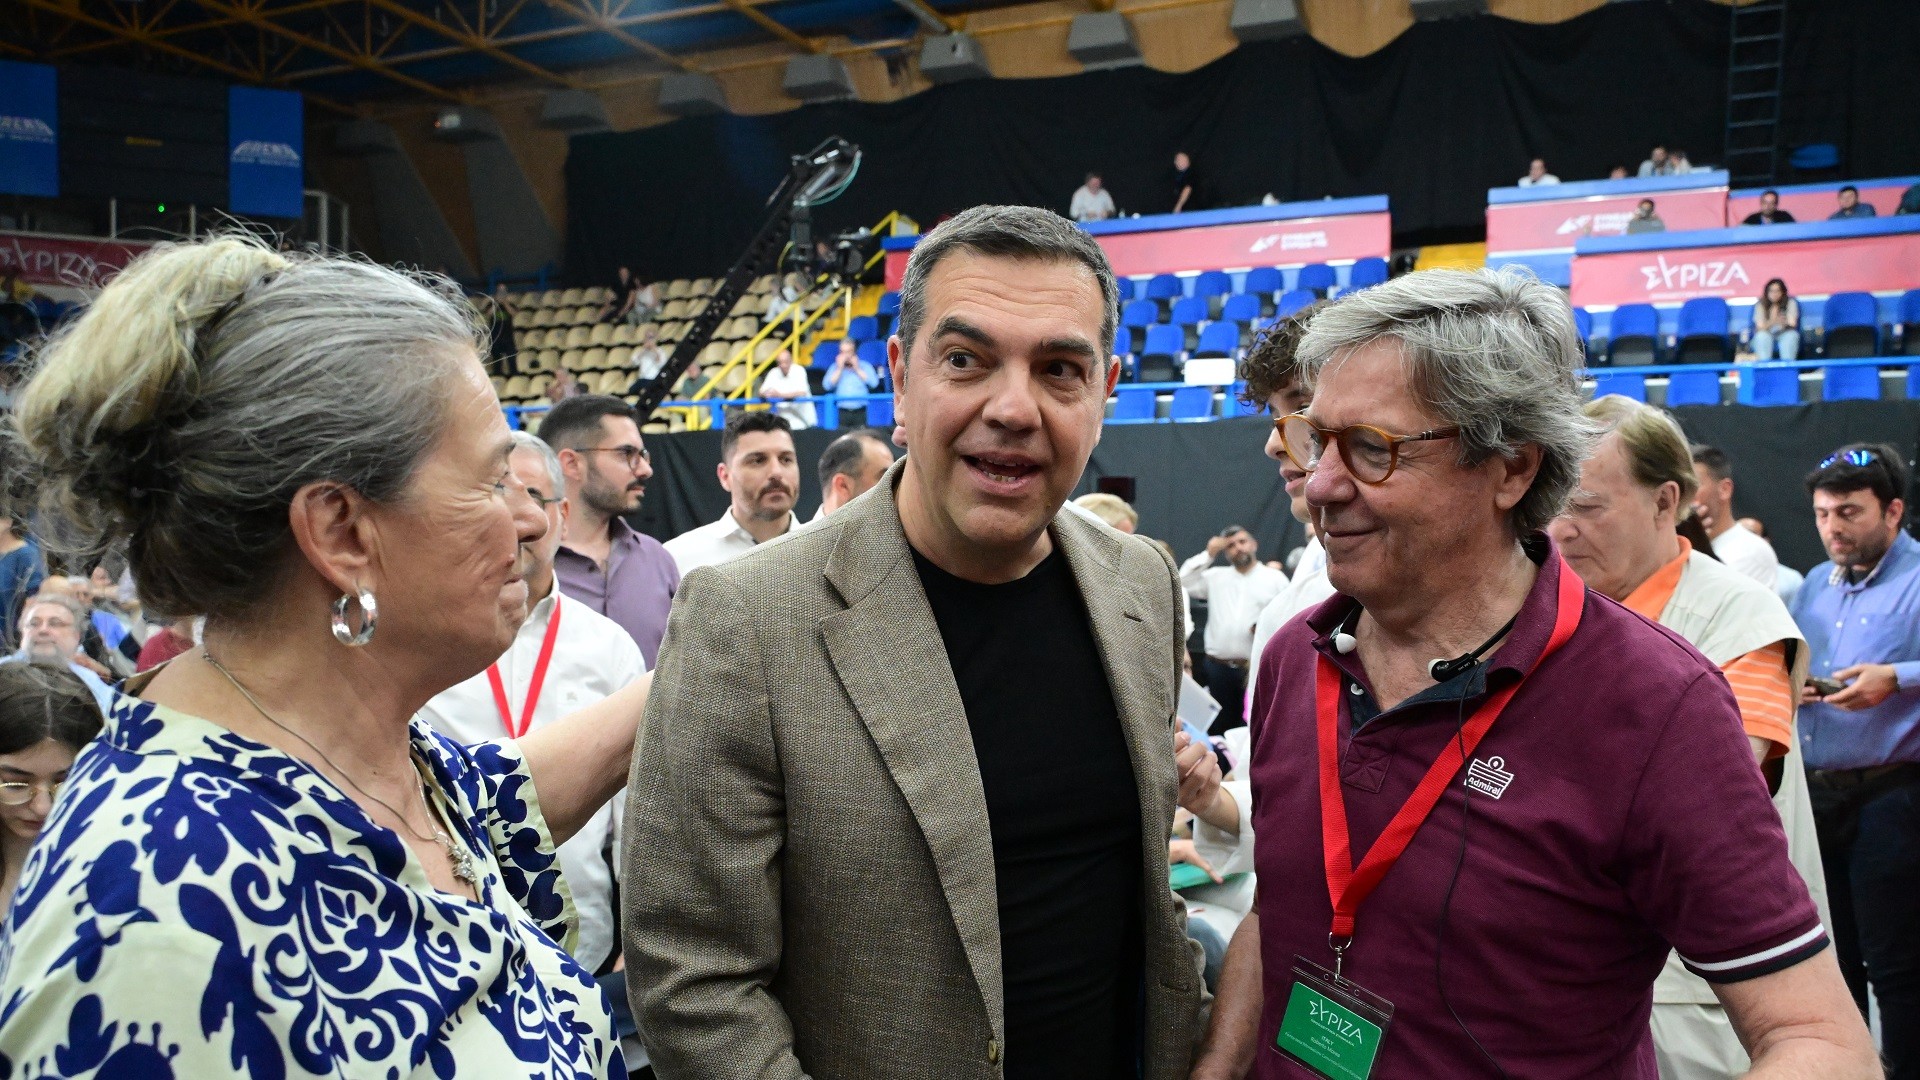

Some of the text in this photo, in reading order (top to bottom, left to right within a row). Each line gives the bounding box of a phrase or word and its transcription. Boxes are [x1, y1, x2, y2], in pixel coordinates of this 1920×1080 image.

[1640, 254, 1750, 290] ΣΥΡΙΖΑ
[1468, 777, 1501, 796] Admiral
[1309, 999, 1363, 1045] ΣΥΡΙΖΑ
